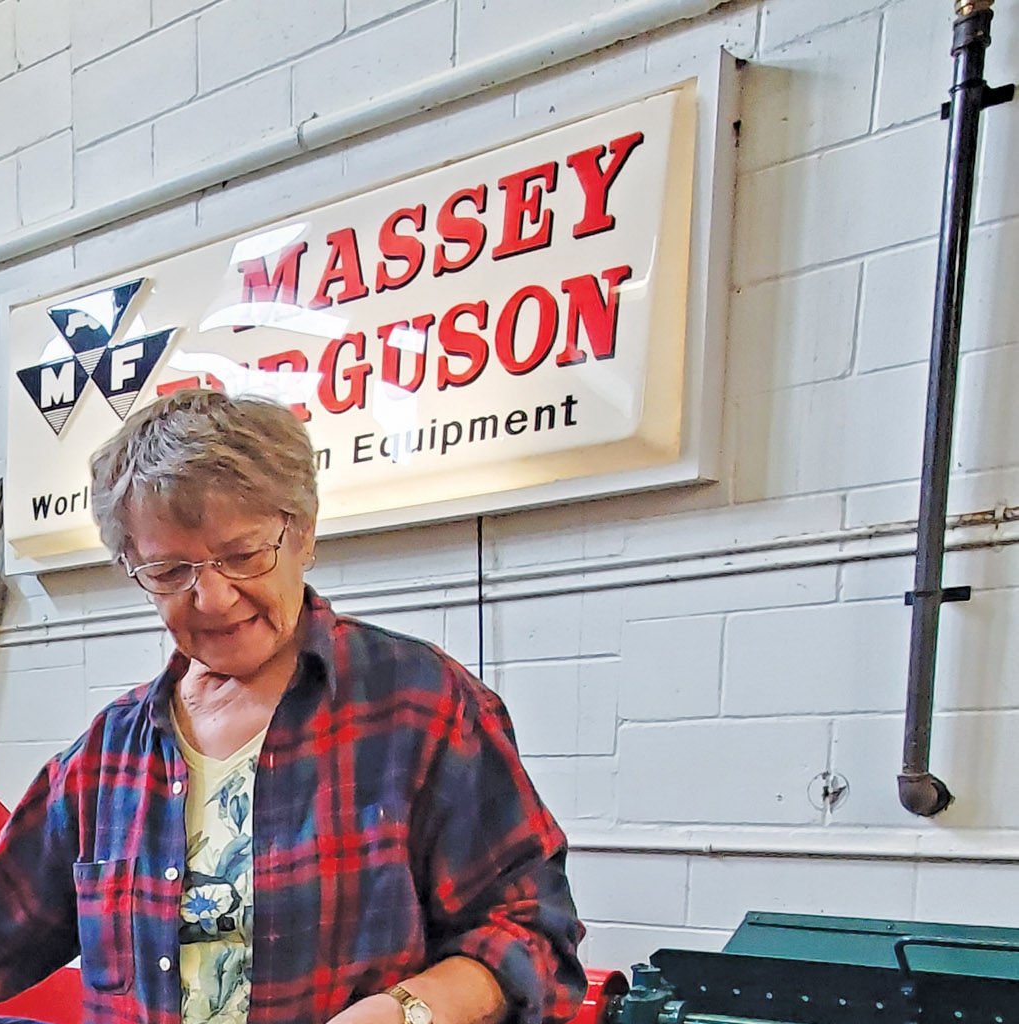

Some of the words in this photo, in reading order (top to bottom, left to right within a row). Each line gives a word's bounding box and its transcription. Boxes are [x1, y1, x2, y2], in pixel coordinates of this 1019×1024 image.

[233, 131, 644, 333] MASSEY
[32, 485, 88, 521] Worl
[353, 394, 578, 464] Equipment
